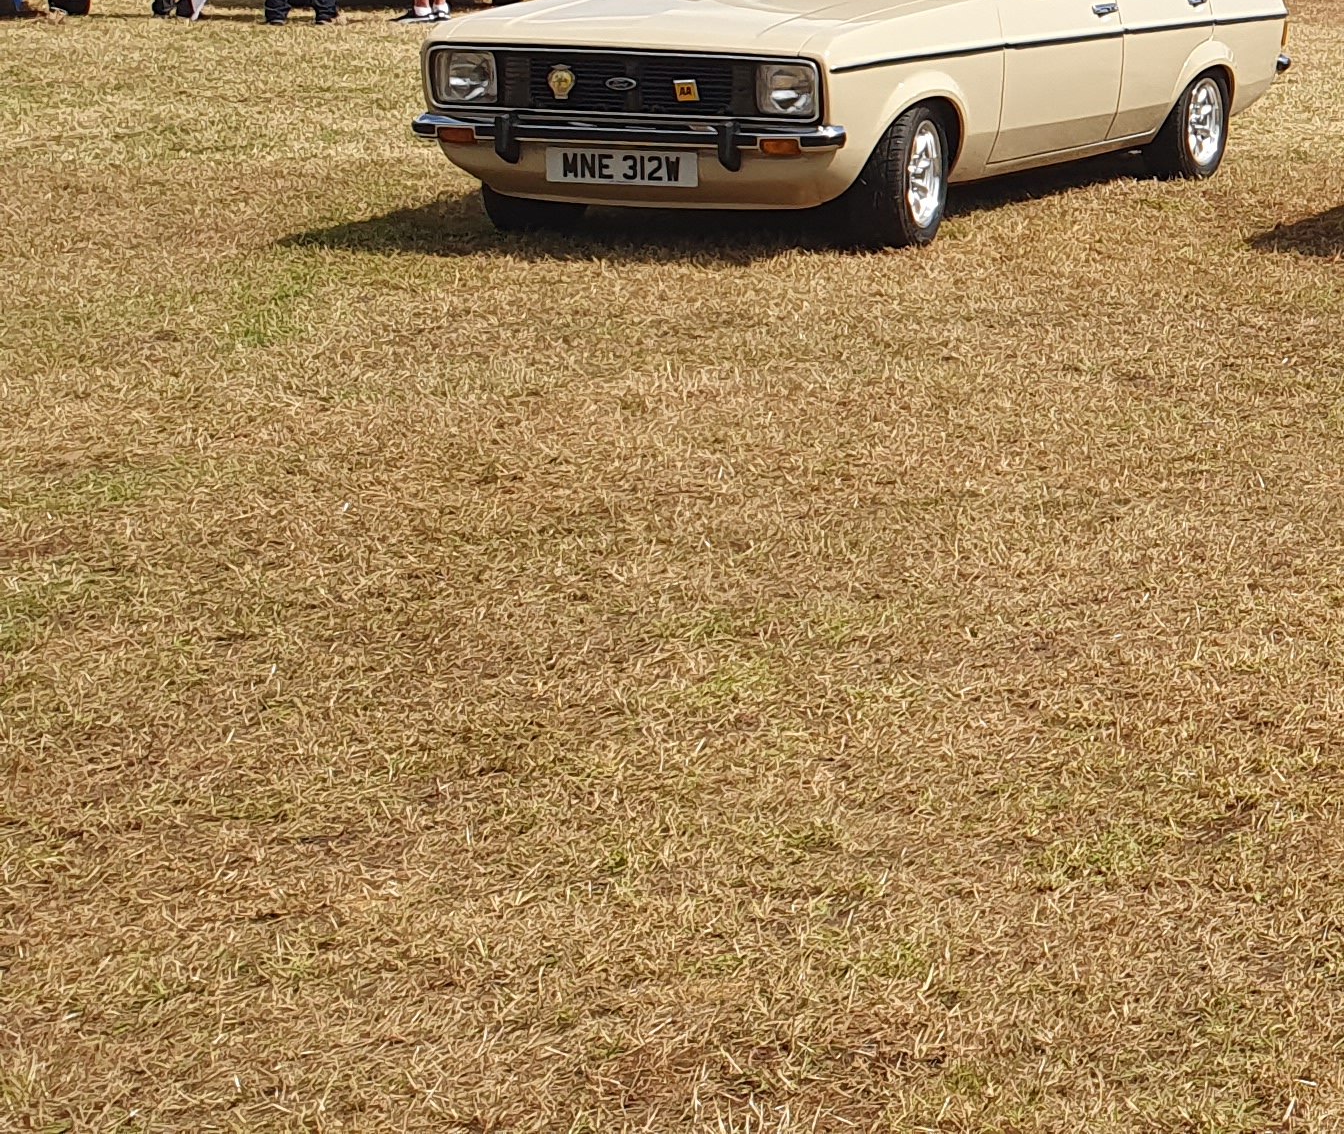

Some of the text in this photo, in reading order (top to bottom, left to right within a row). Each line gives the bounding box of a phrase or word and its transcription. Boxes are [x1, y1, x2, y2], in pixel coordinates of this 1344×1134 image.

[679, 86, 692, 96] AA
[562, 152, 681, 182] MNE 312W
